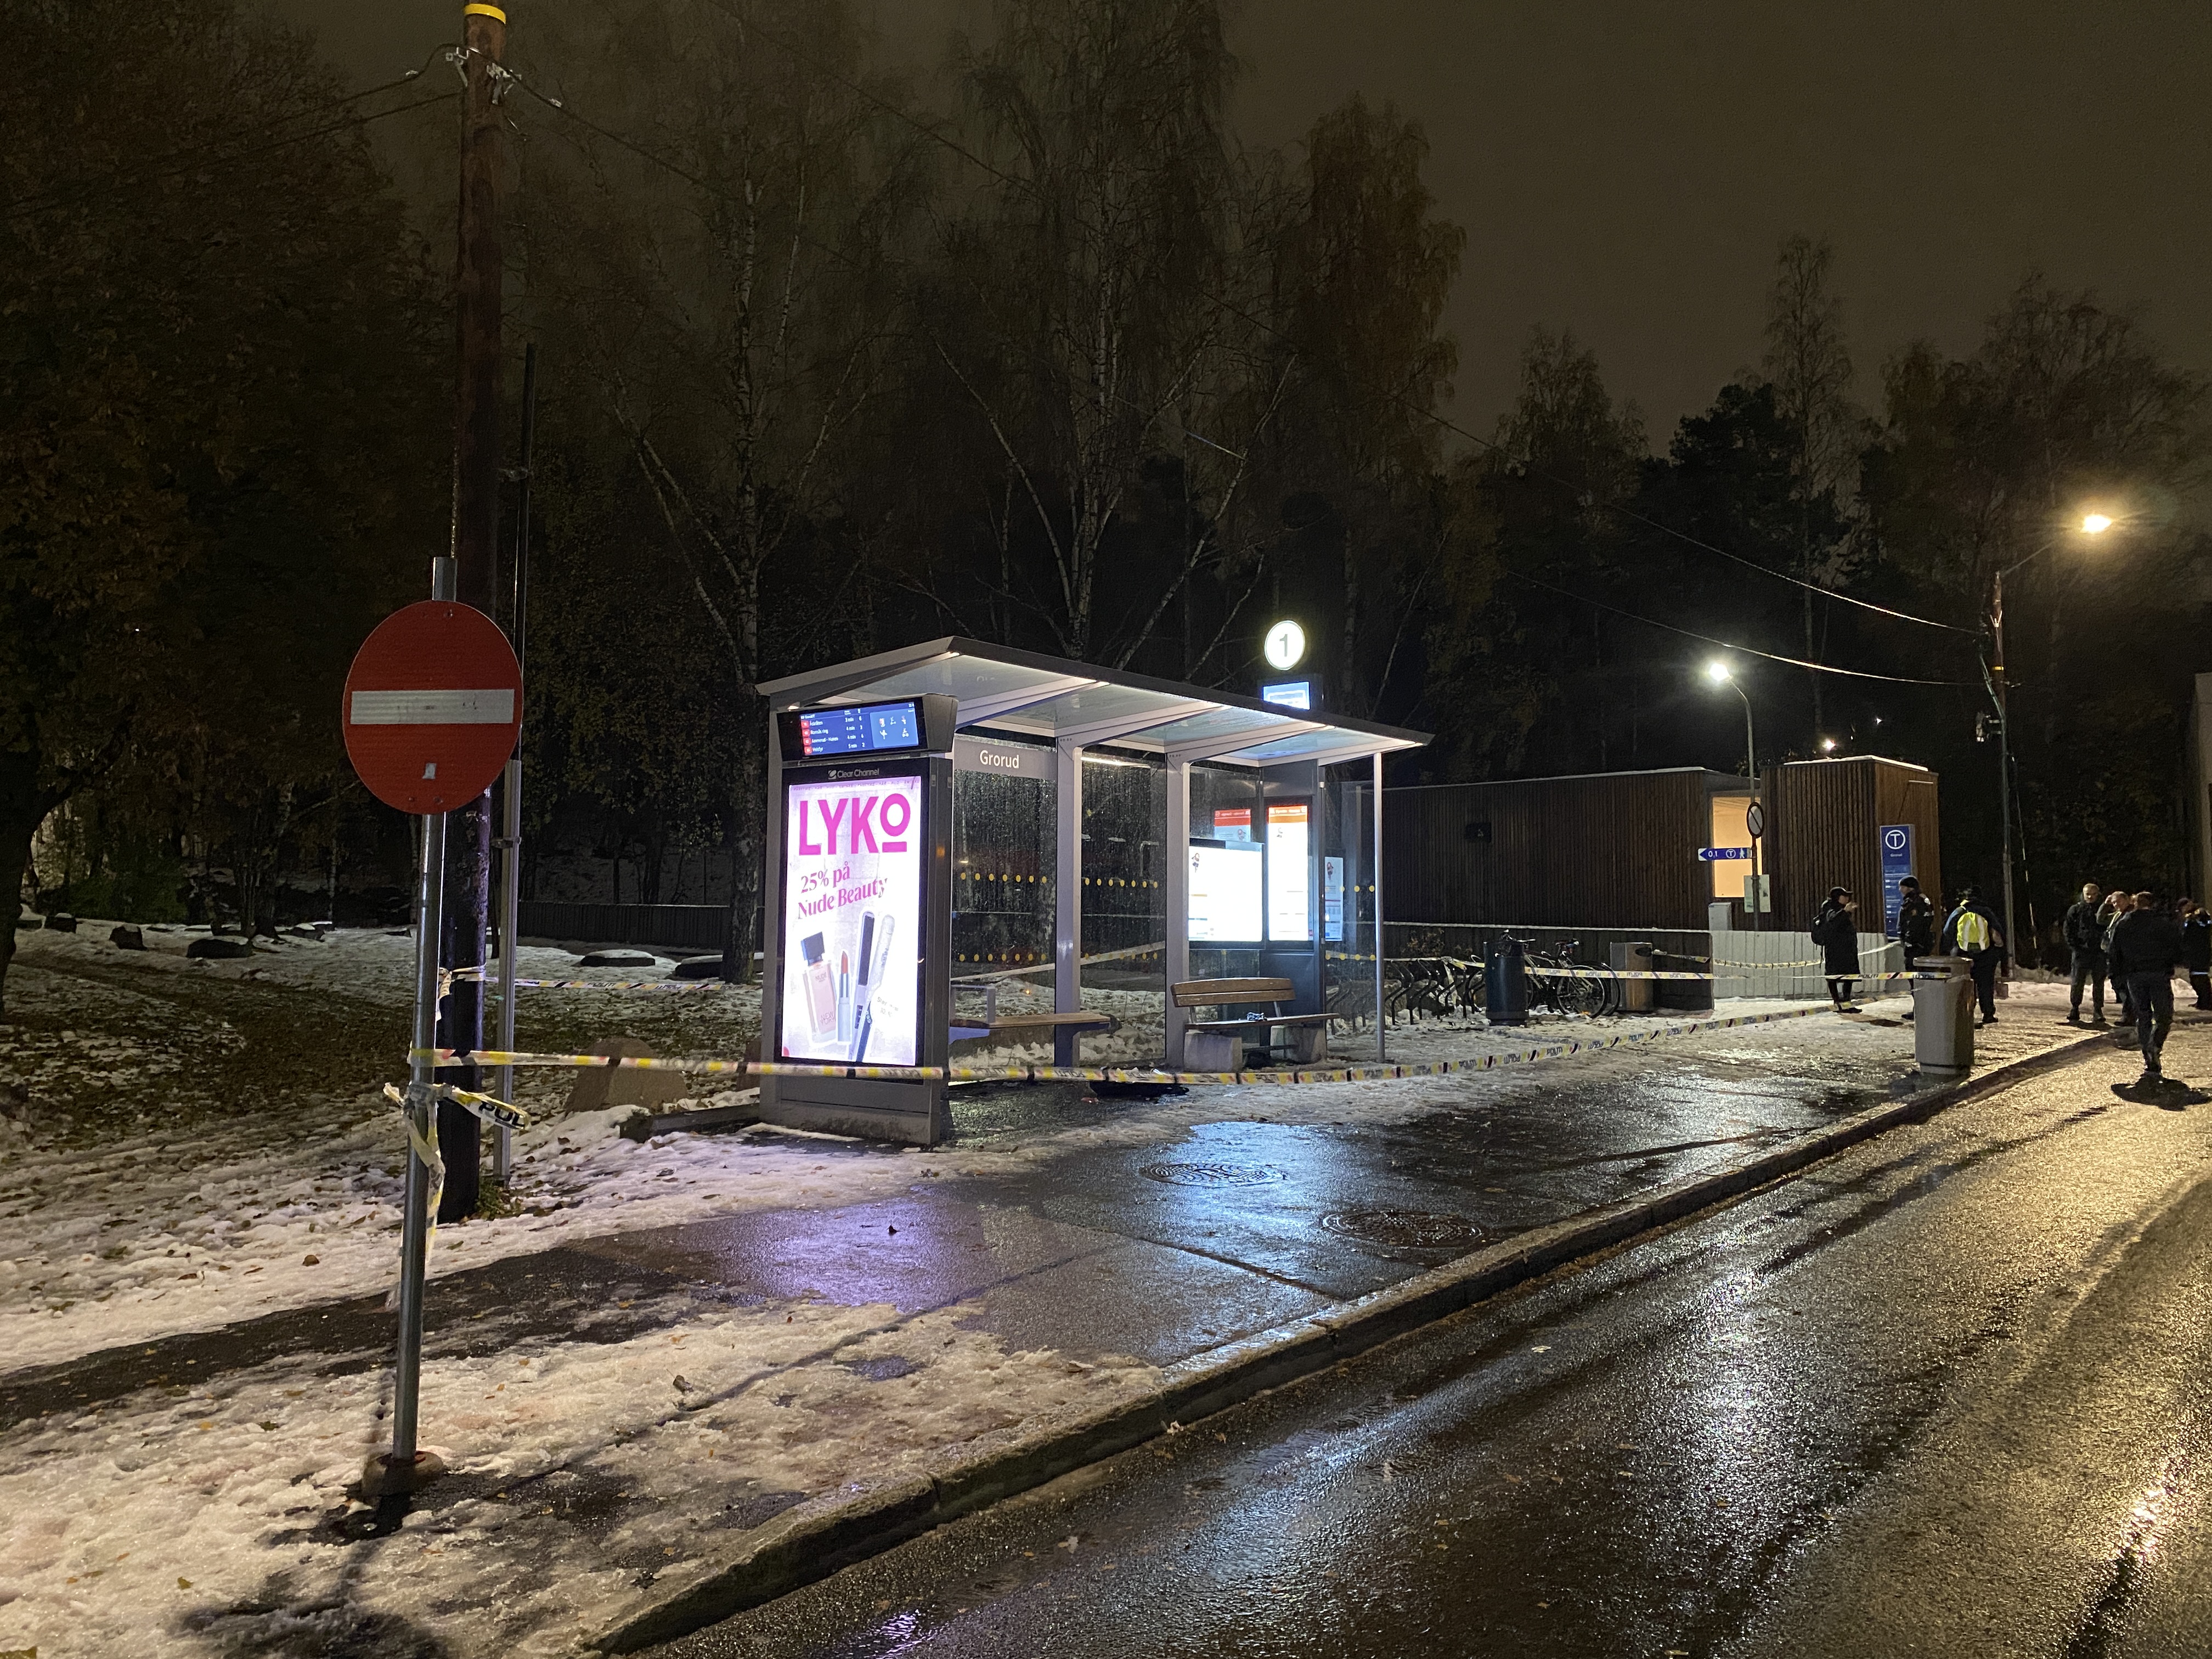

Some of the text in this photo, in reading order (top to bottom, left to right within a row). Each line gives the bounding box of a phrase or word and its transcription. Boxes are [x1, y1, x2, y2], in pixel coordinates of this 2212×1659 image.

[1279, 634, 1288, 657] 1
[854, 768, 879, 777] Channel
[979, 749, 1020, 769] Grorud
[799, 793, 911, 855] LYKO
[801, 861, 850, 893] 25% på
[798, 878, 888, 919] Nude Beauty
